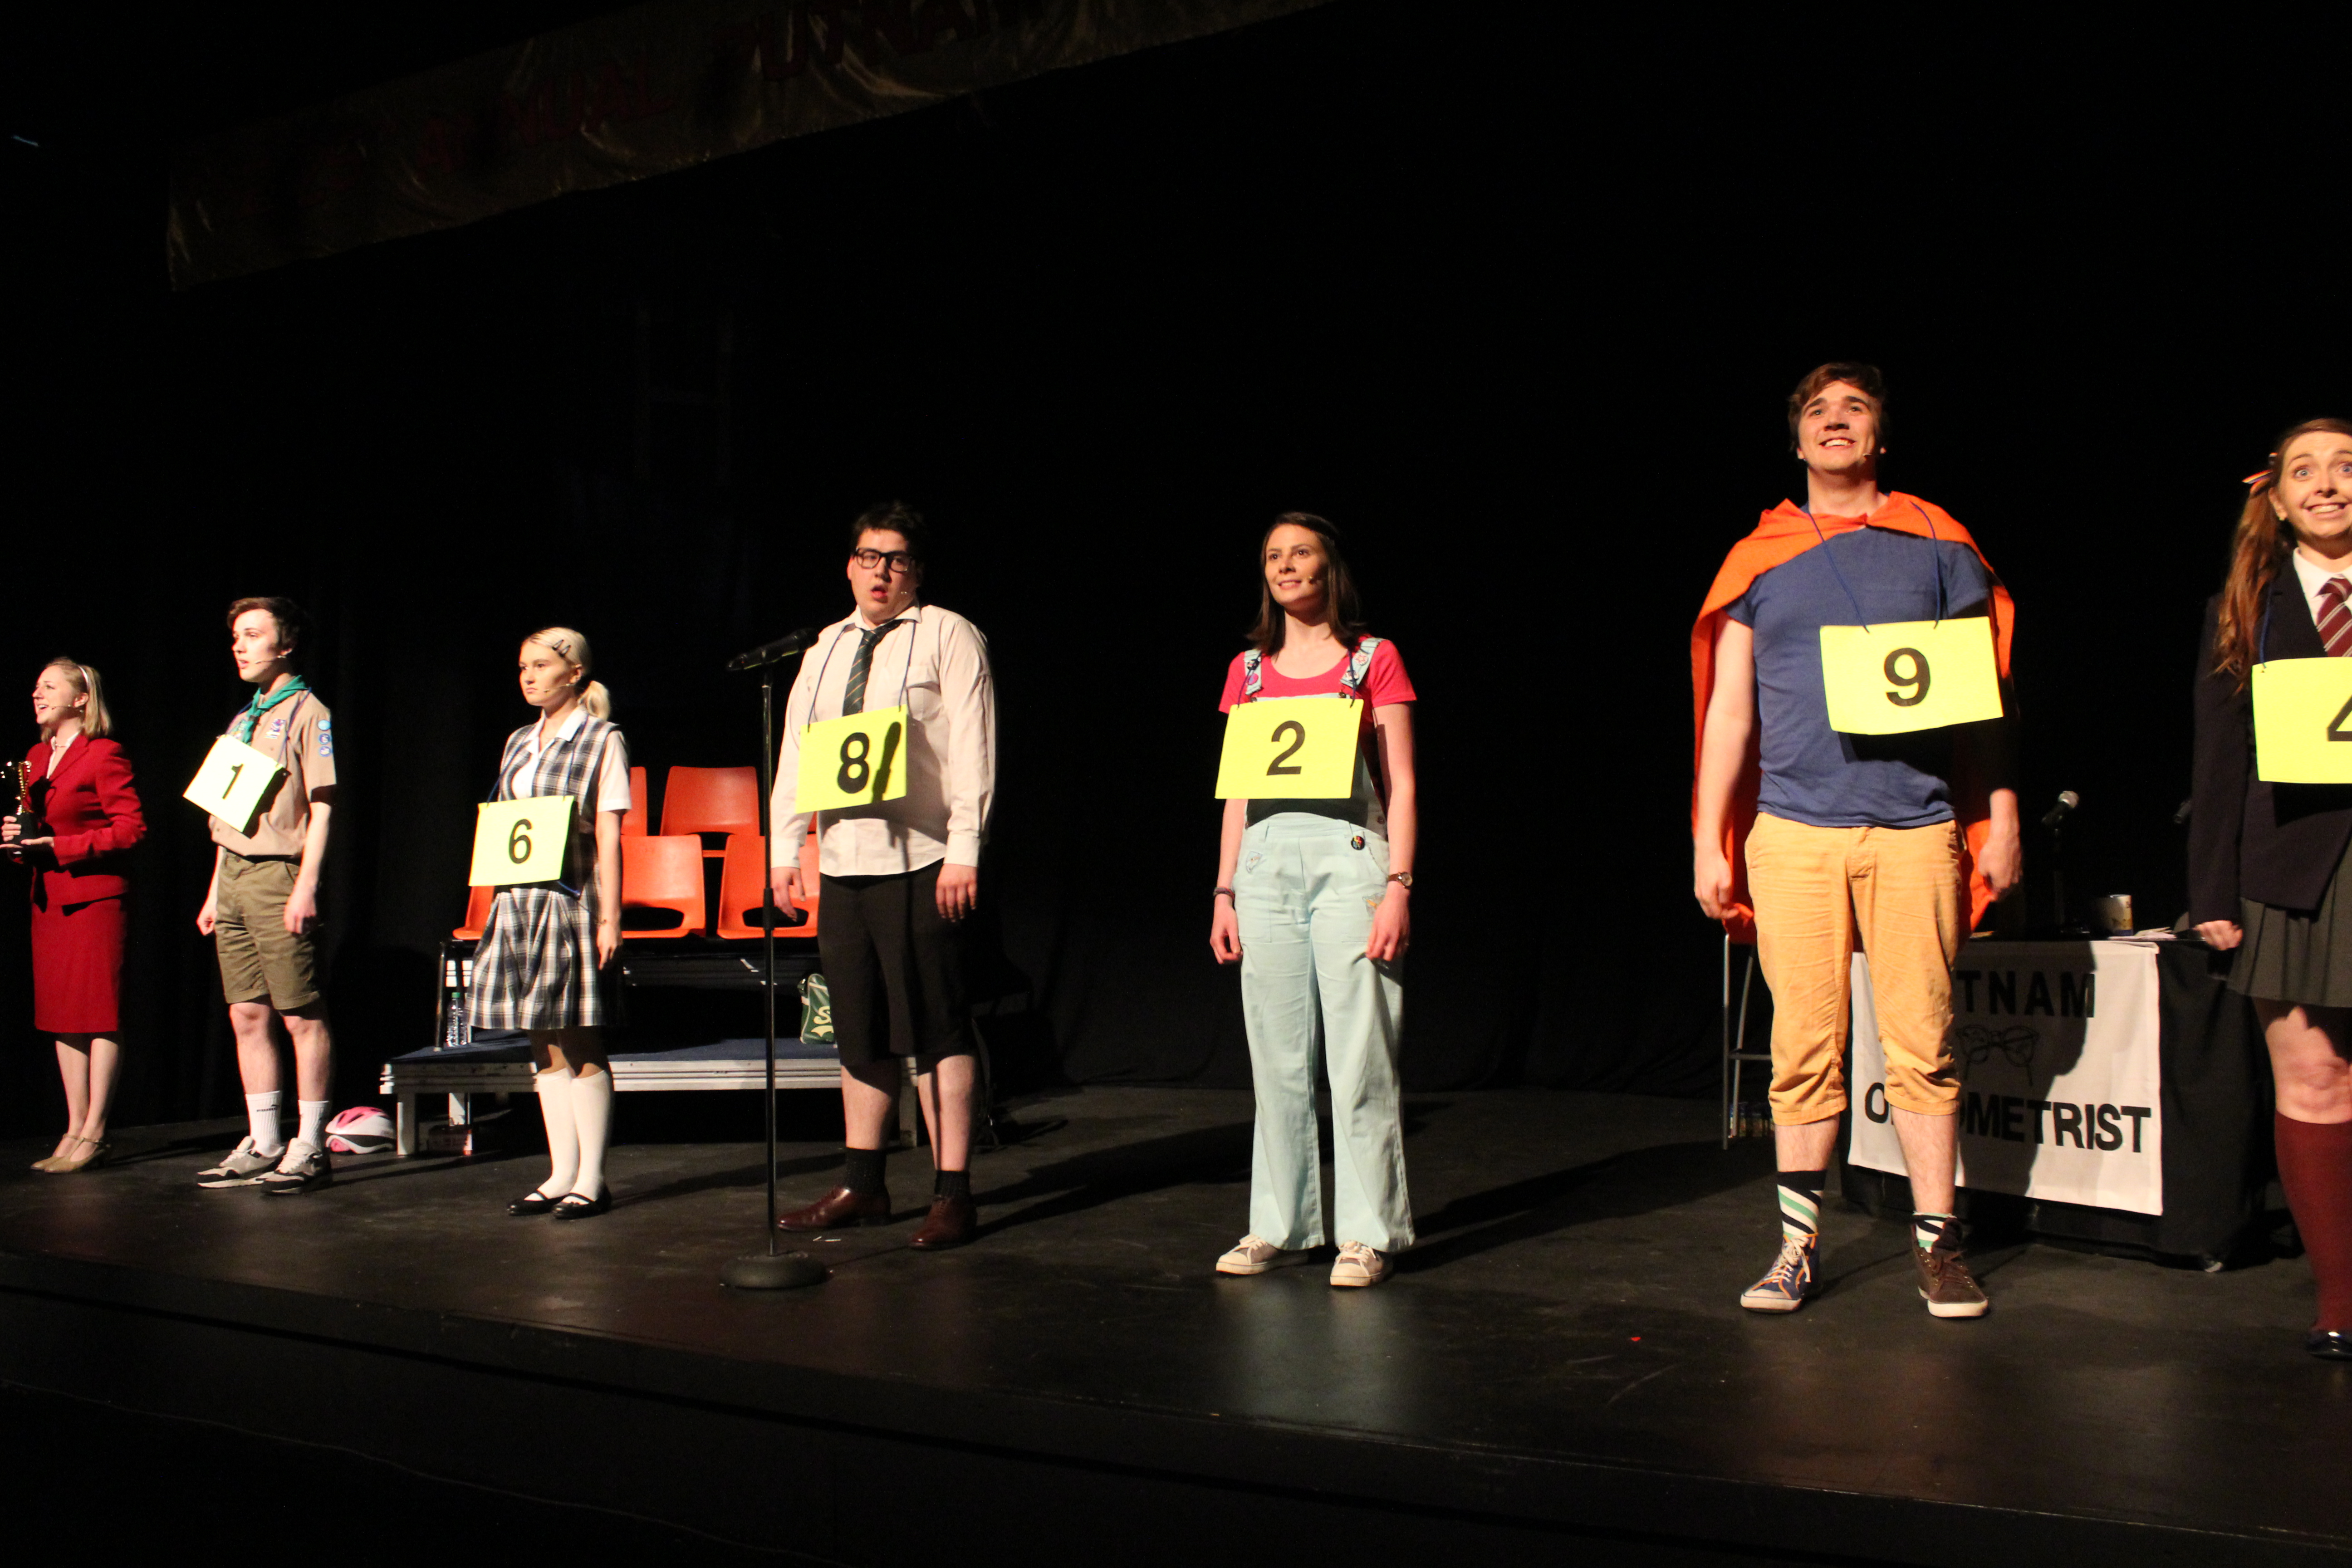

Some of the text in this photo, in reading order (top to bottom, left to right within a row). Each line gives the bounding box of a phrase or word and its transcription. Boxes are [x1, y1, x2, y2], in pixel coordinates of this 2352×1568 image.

[1884, 647, 1931, 707] 9
[837, 732, 870, 794] 8
[1266, 720, 1305, 776] 2
[222, 763, 244, 799] 1
[508, 818, 532, 864] 6
[1956, 970, 2095, 1018] TNAM
[1865, 1082, 2151, 1153] OMETRIST
